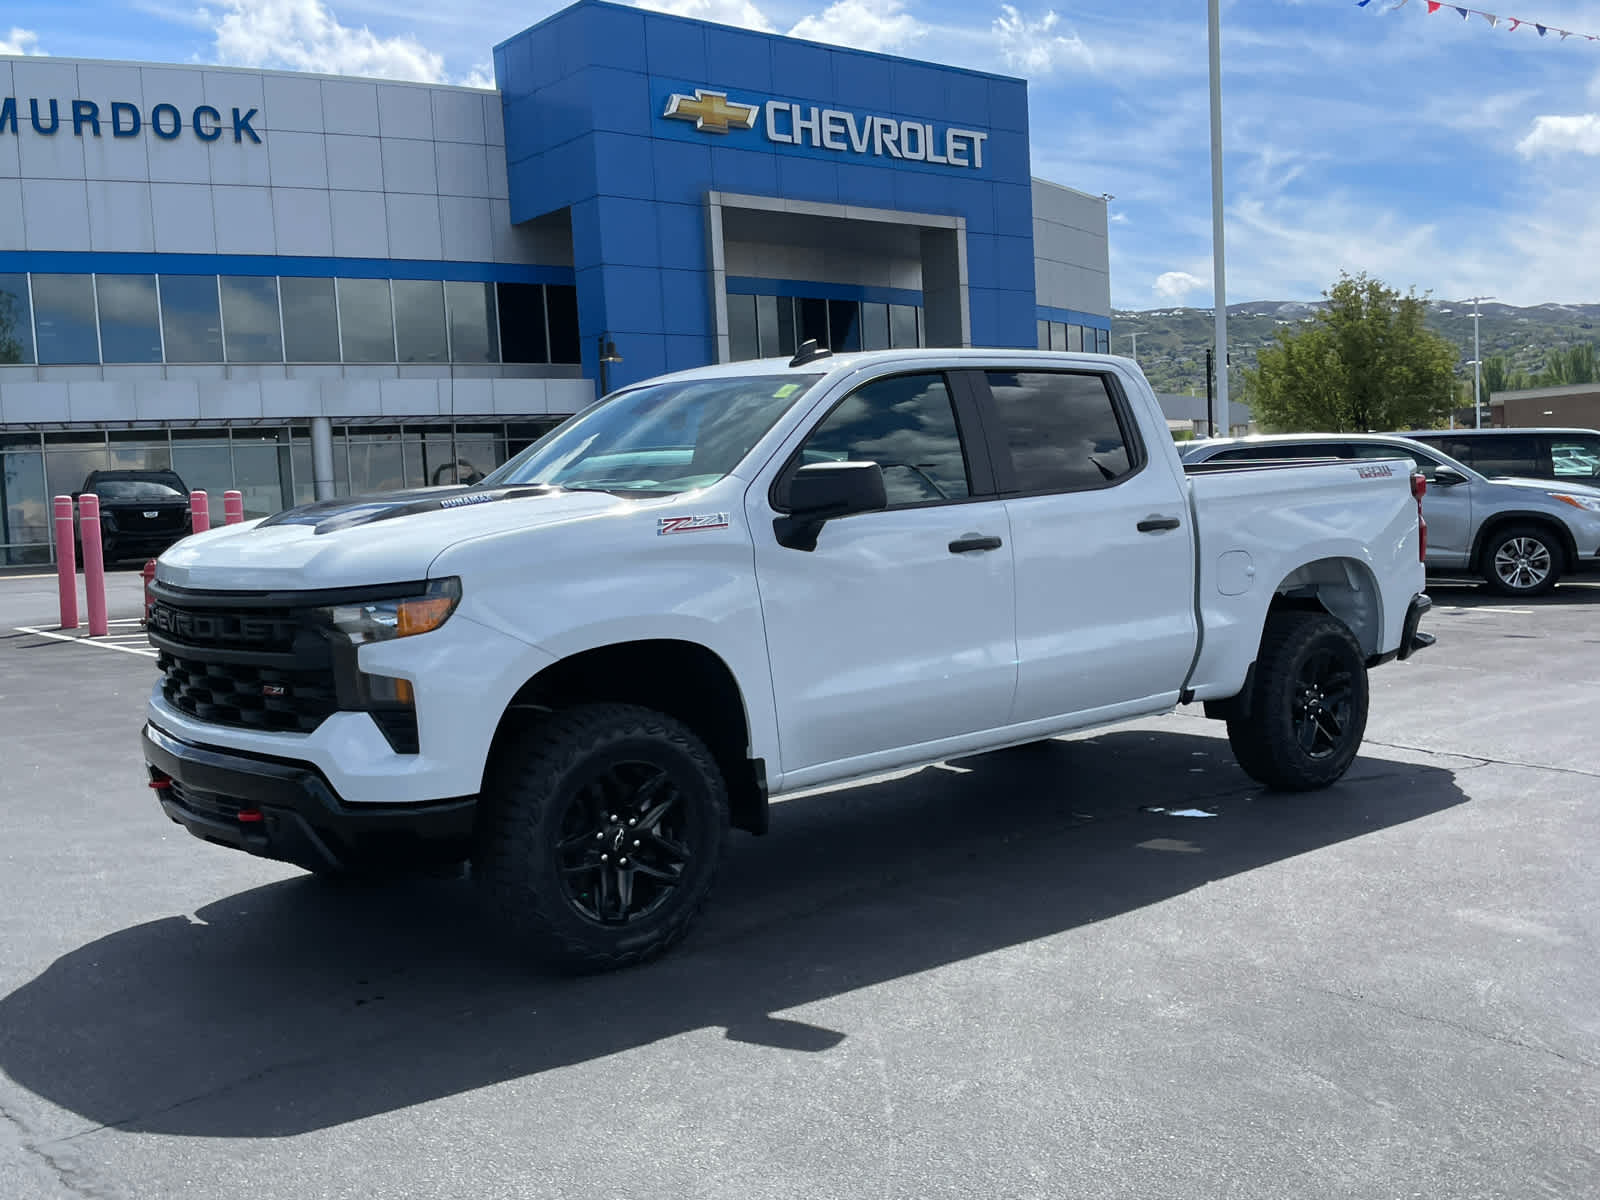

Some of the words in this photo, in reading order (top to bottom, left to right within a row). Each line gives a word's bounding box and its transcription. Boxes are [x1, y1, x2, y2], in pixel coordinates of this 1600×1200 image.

[765, 100, 988, 168] CHEVROLET
[657, 512, 729, 535] Z71
[150, 606, 302, 640] HEVROLET
